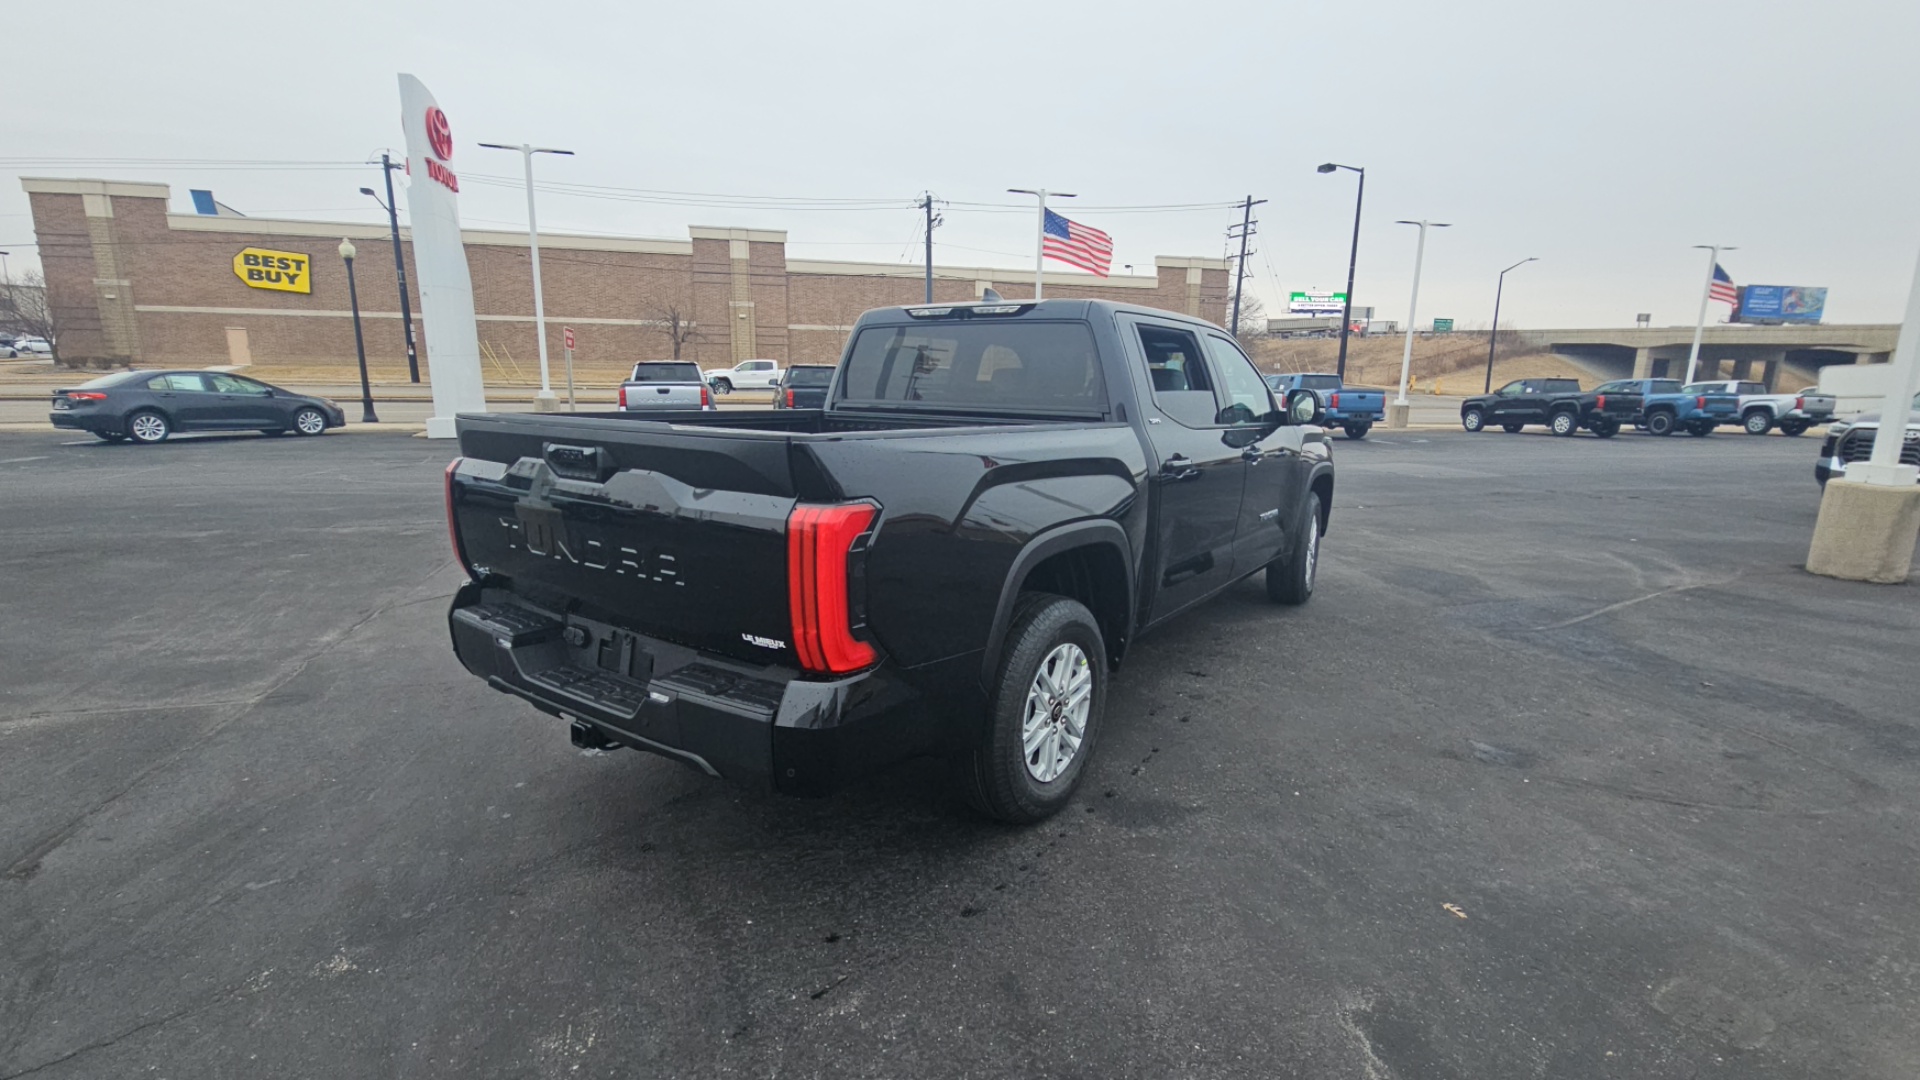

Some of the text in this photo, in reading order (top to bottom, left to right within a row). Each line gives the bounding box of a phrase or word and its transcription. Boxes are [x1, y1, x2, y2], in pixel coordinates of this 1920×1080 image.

[424, 156, 459, 193] TOYOTA
[243, 253, 306, 272] BEST
[247, 268, 301, 285] BUY
[498, 516, 686, 587] TUNDRA
